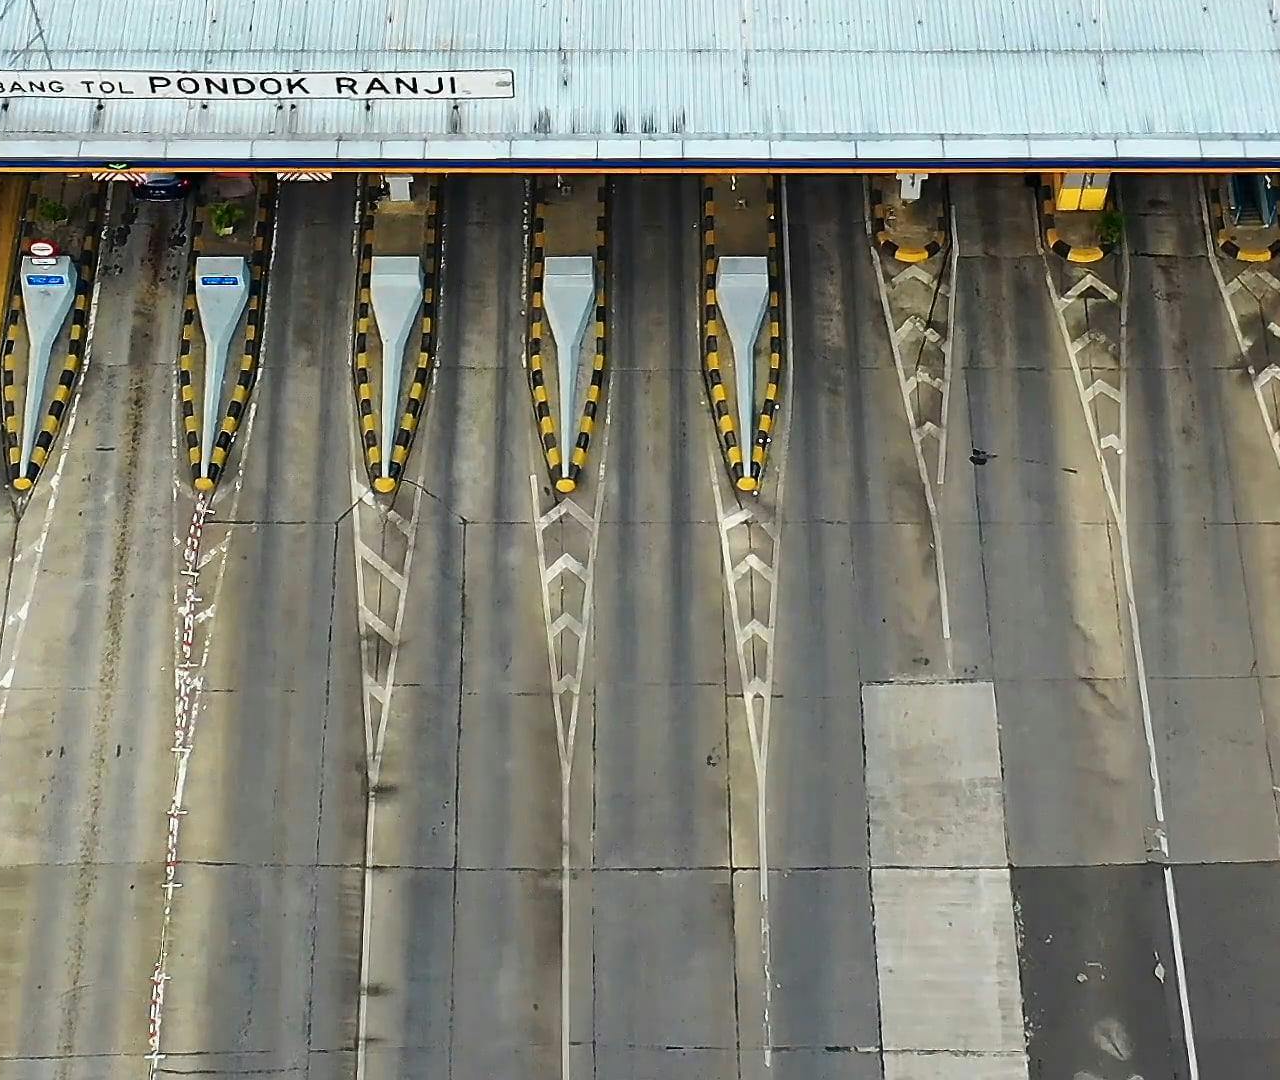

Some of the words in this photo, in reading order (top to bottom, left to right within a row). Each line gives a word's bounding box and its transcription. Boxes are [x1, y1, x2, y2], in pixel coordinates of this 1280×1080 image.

[81, 80, 134, 94] TOL
[149, 75, 310, 95] PONDOK
[336, 76, 458, 95] RANJI
